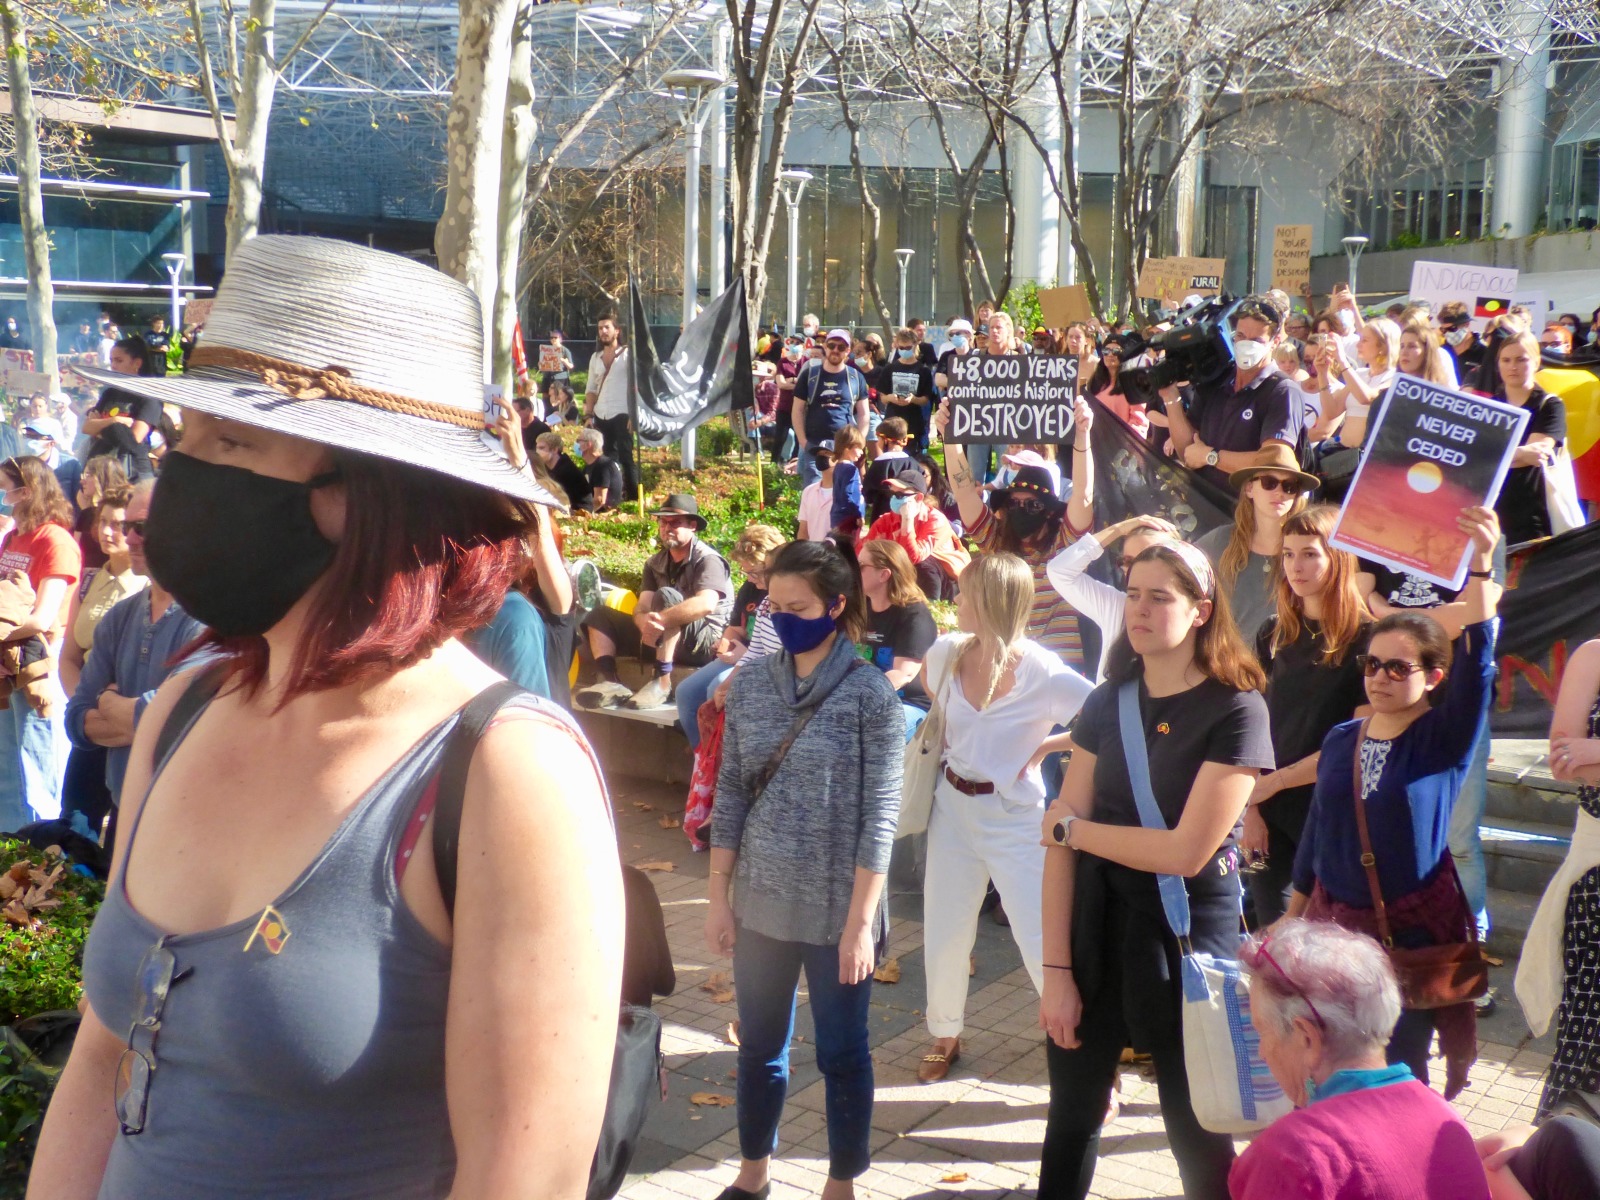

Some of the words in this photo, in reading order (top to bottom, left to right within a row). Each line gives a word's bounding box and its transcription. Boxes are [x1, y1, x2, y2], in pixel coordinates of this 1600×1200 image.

[1276, 227, 1297, 237] NOT
[1283, 238, 1308, 248] YOUR
[1274, 249, 1310, 259] COUNTRY
[1279, 259, 1288, 267] TO
[1276, 267, 1309, 277] DESTROY
[1417, 266, 1515, 294] INDIGENOUS
[952, 356, 1020, 383] 48,000
[1027, 356, 1078, 381] YEARS
[948, 382, 1021, 399] continuous
[1024, 380, 1075, 408] history
[1394, 380, 1518, 430] SOVEREIGNTY
[953, 403, 1075, 439] DESTROYED
[1415, 414, 1477, 445] NEVER
[1407, 437, 1467, 467] CEDED
